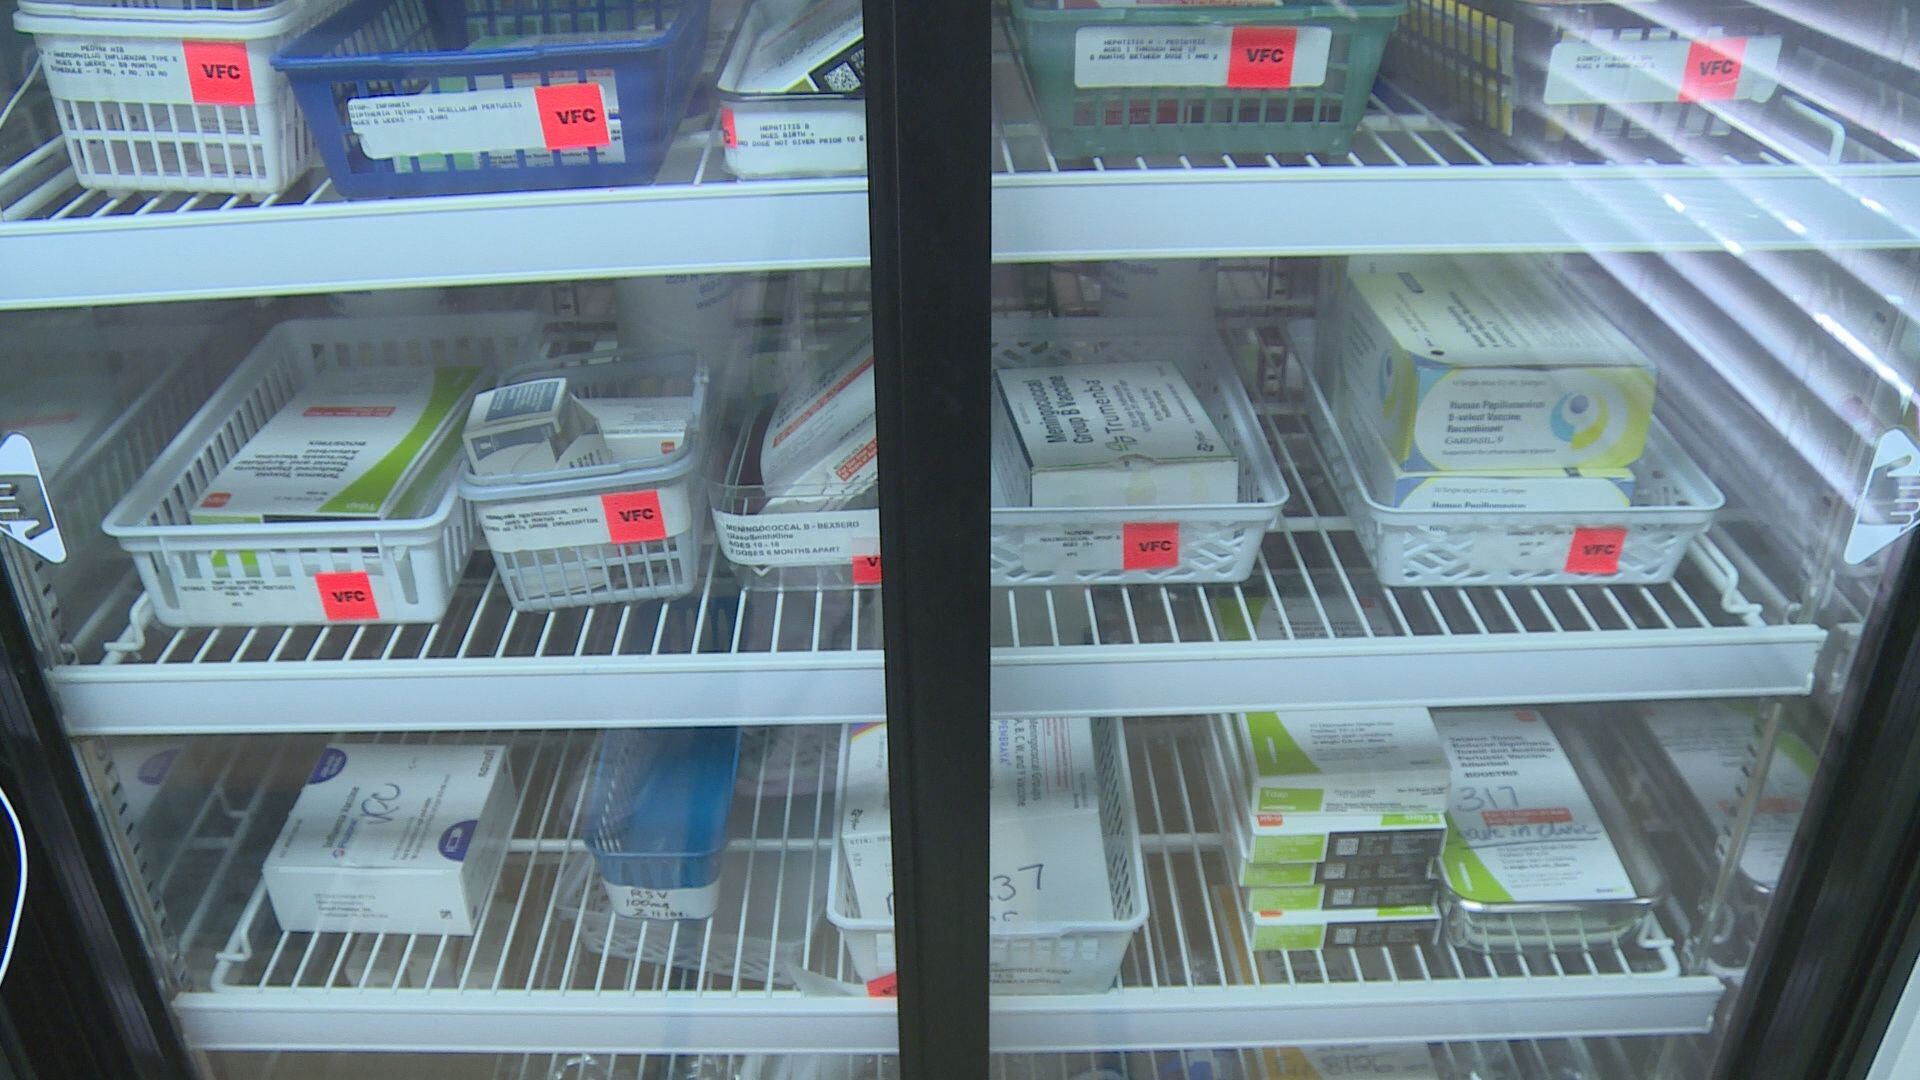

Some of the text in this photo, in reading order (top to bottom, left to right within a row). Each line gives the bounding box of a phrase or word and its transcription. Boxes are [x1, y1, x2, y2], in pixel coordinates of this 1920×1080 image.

[1246, 47, 1284, 63] VFC
[201, 63, 240, 80] VFC
[1700, 59, 1734, 76] VFC
[554, 107, 596, 125] VFC
[760, 123, 801, 131] HEPATITIS
[819, 136, 842, 144] PRIOR
[1024, 378, 1068, 443] Meningococcal
[1048, 375, 1094, 444] Group B Vaccine
[1083, 378, 1125, 434] Trumenba
[1450, 400, 1546, 411] Human Papillomavirus
[1447, 424, 1504, 433] Recombinant
[1432, 501, 1463, 509] Human
[617, 507, 655, 524] VFC
[726, 520, 860, 533] MENINGOCOCCAL B BEXSERO
[729, 540, 751, 549] AGES
[1138, 540, 1173, 552] VFC
[1583, 544, 1616, 555] VFC
[736, 549, 765, 557] DOSES
[813, 546, 841, 554] APART
[332, 589, 366, 605] VFC
[478, 748, 497, 778] sanofi
[1464, 770, 1519, 779] BOOSTRIX
[1455, 785, 1519, 812] 317
[630, 889, 668, 900] RSV
